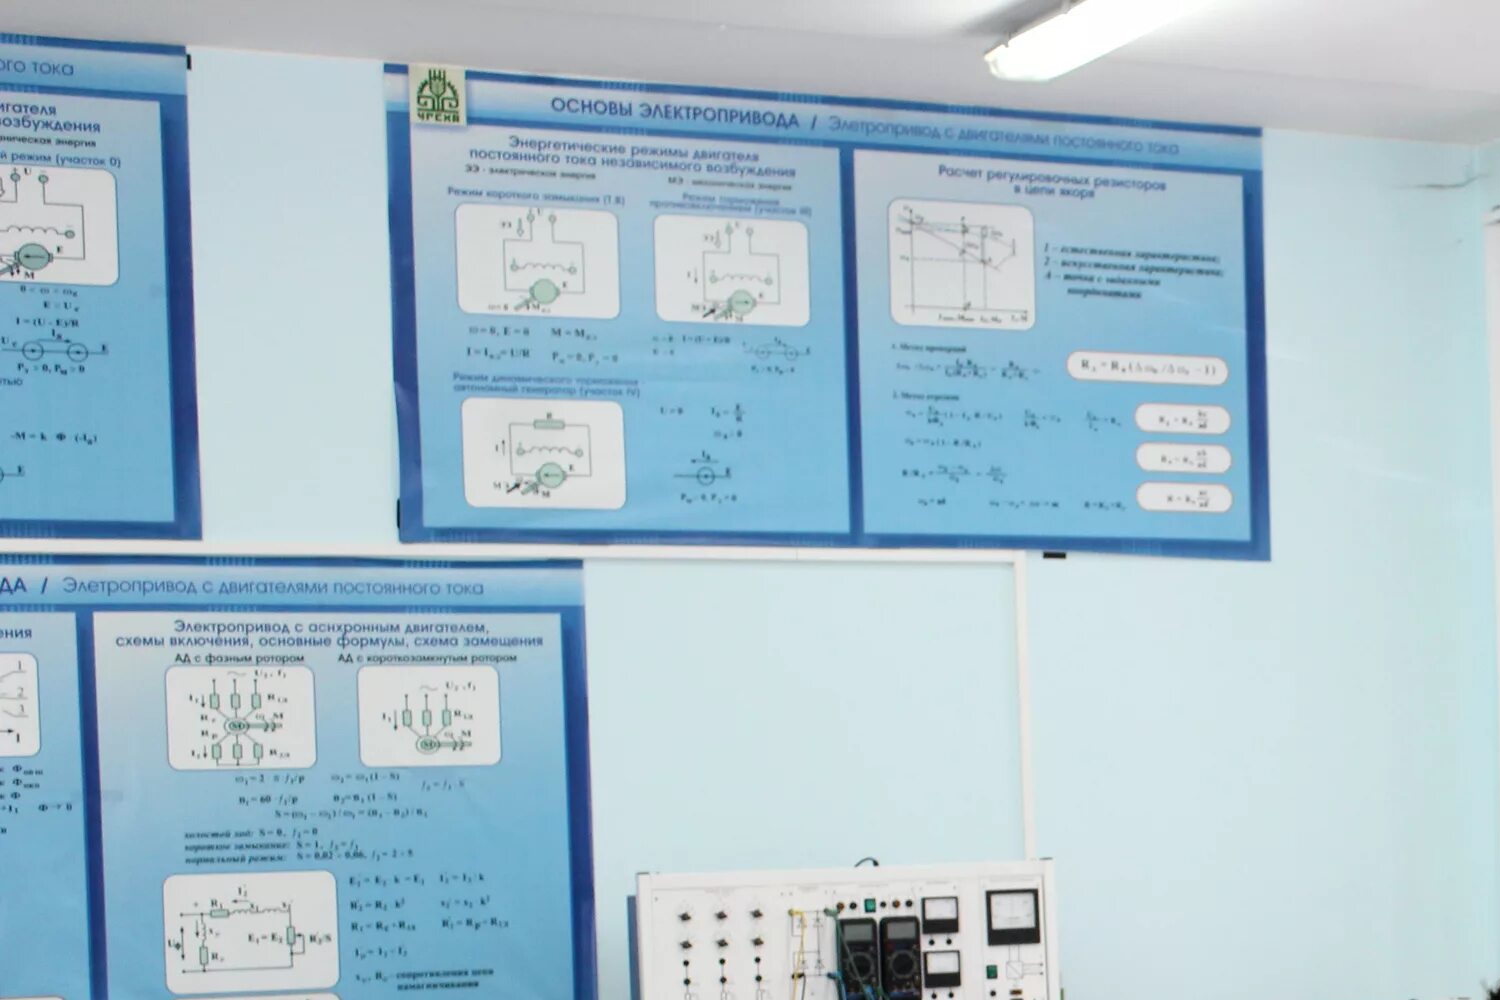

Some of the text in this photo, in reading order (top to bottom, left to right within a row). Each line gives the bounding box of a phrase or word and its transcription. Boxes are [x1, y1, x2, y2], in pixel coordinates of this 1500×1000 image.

[31, 61, 75, 76] тока
[0, 116, 101, 133] озбуждения
[551, 96, 633, 117] ОСНОВЫ
[639, 103, 799, 129] ЭЛЕКТРОПРИВОДА
[958, 129, 1050, 146] двигателями
[1053, 134, 1144, 153] постоянного
[1147, 142, 1180, 155] тока
[11, 152, 52, 162] режим
[508, 134, 760, 163] Энергетические режимы двигателя
[469, 148, 796, 179] постоянного тока независимого возбуждения
[938, 163, 1167, 192] Расчет регулировочных резисторов
[62, 576, 197, 597] Элетропривод
[202, 579, 213, 593] с
[219, 580, 328, 596] двигателями
[333, 582, 440, 598] постоянного
[447, 583, 485, 596] тока
[173, 619, 290, 635] Электропривод
[294, 622, 304, 633] с
[404, 622, 490, 635] двигателем,
[115, 630, 544, 650] схемы включения, основные формулы, схема замещения
[174, 652, 305, 665] АД с фазным ротором
[337, 653, 354, 664] АД
[366, 654, 468, 666] короткозамкнутым
[471, 654, 517, 665] ротором
